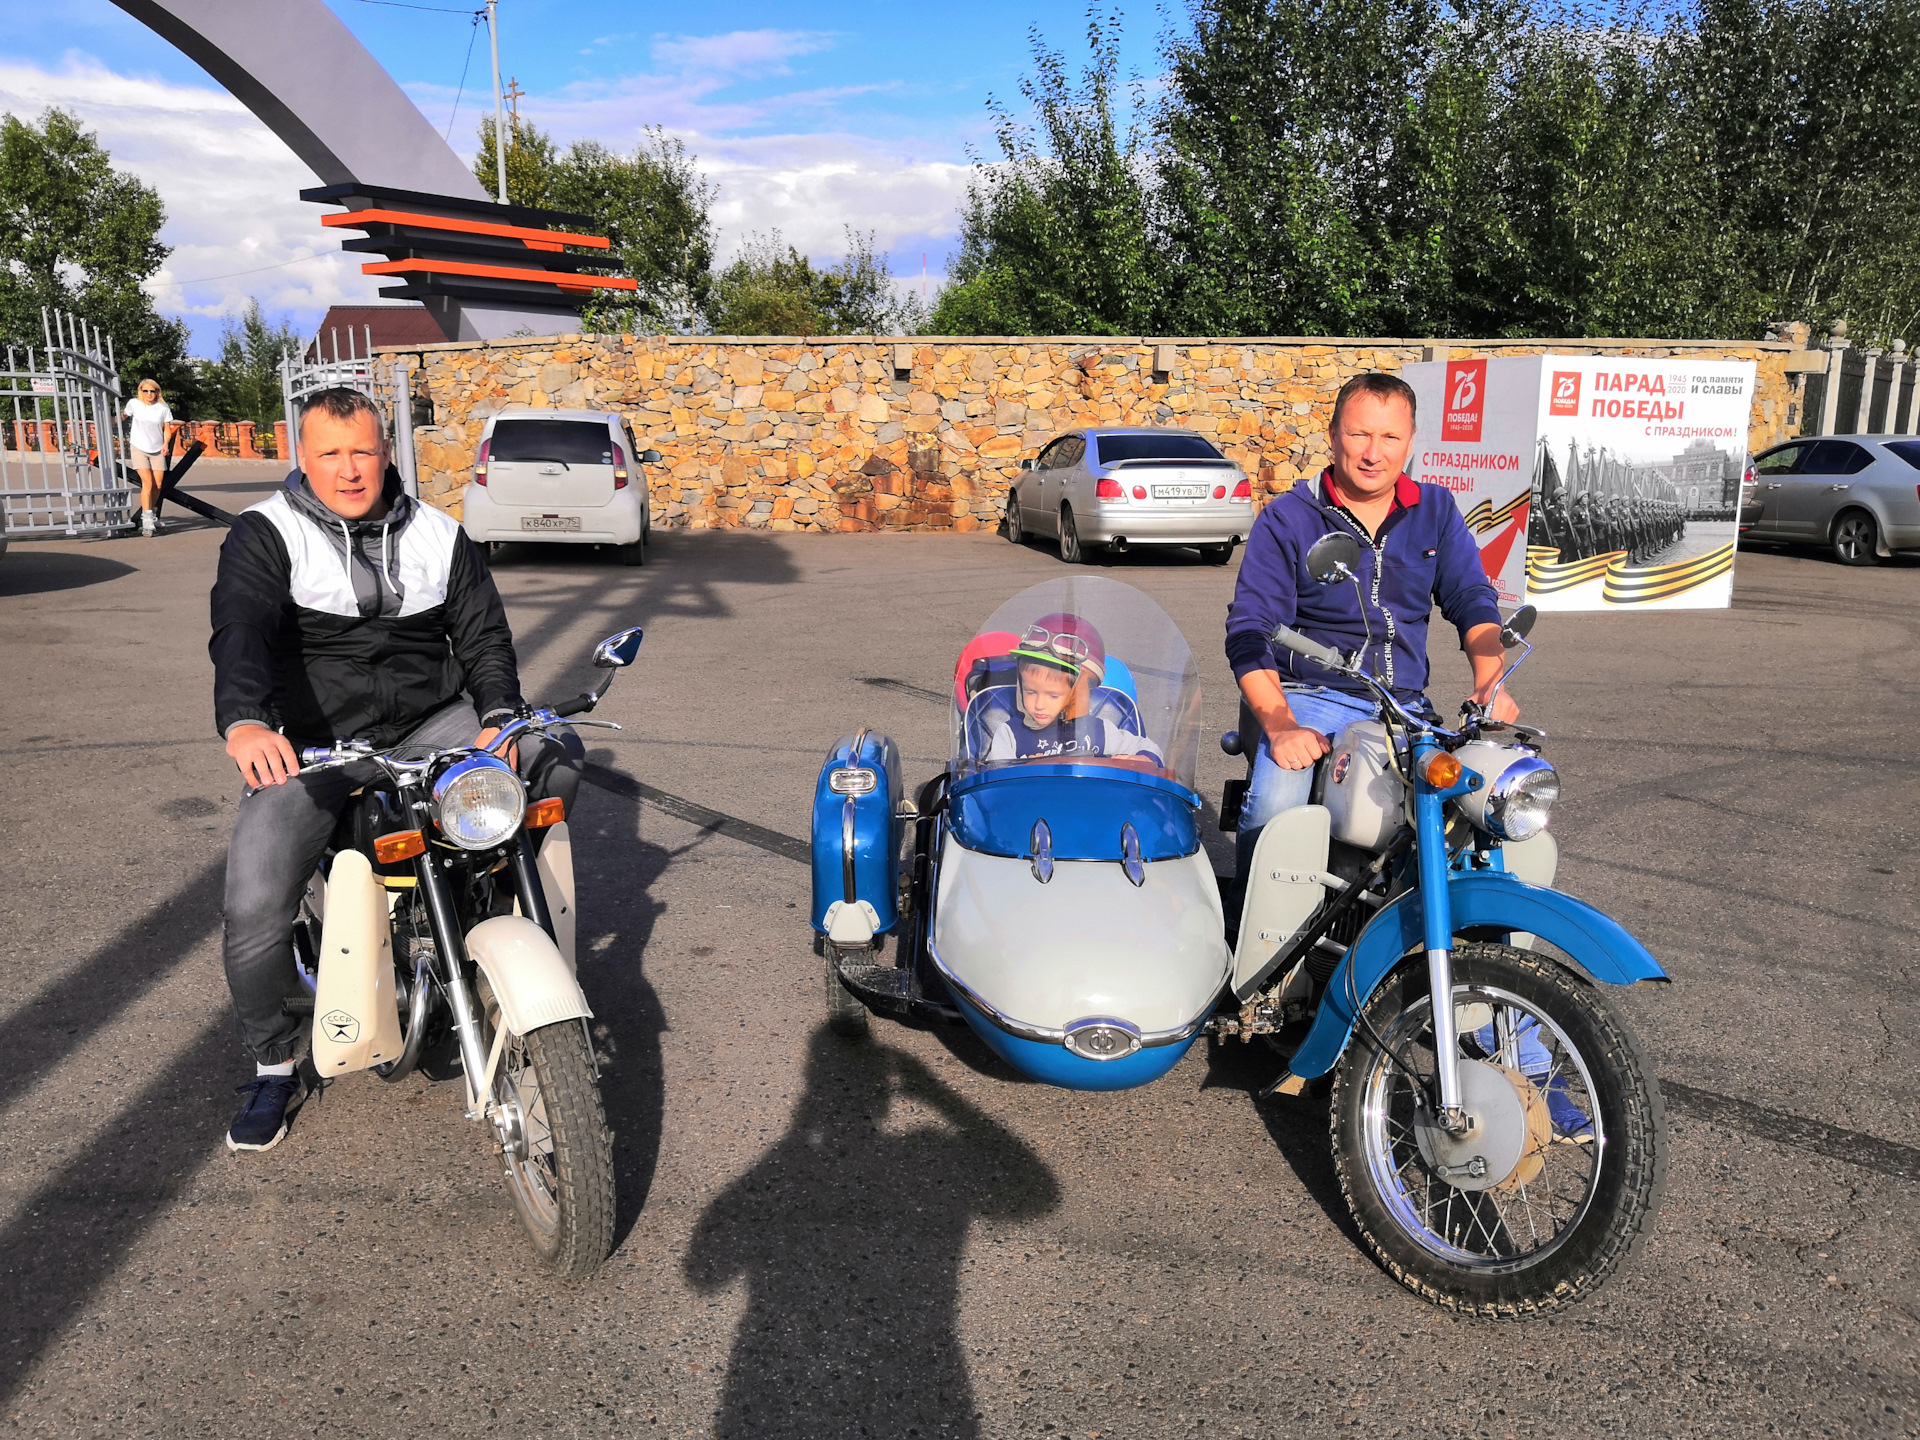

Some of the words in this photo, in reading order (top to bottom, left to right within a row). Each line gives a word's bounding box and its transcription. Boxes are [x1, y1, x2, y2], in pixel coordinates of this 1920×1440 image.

[1668, 374, 1687, 383] 1945
[1691, 375, 1708, 384] год
[1709, 376, 1744, 384] памяти
[1594, 372, 1666, 397] ПАРАД
[1667, 386, 1686, 394] 2020
[1702, 385, 1743, 395] славы
[1591, 398, 1685, 423] ПОБЕДЫ
[1446, 412, 1478, 424] ПОБЕДА!
[1644, 426, 1652, 436] С
[1653, 426, 1738, 438] ПРАЗДНИКОМ!
[1422, 452, 1430, 466] С
[1431, 452, 1519, 471] ПРАЗДНИКОМ
[327, 1015, 352, 1023] СССР
